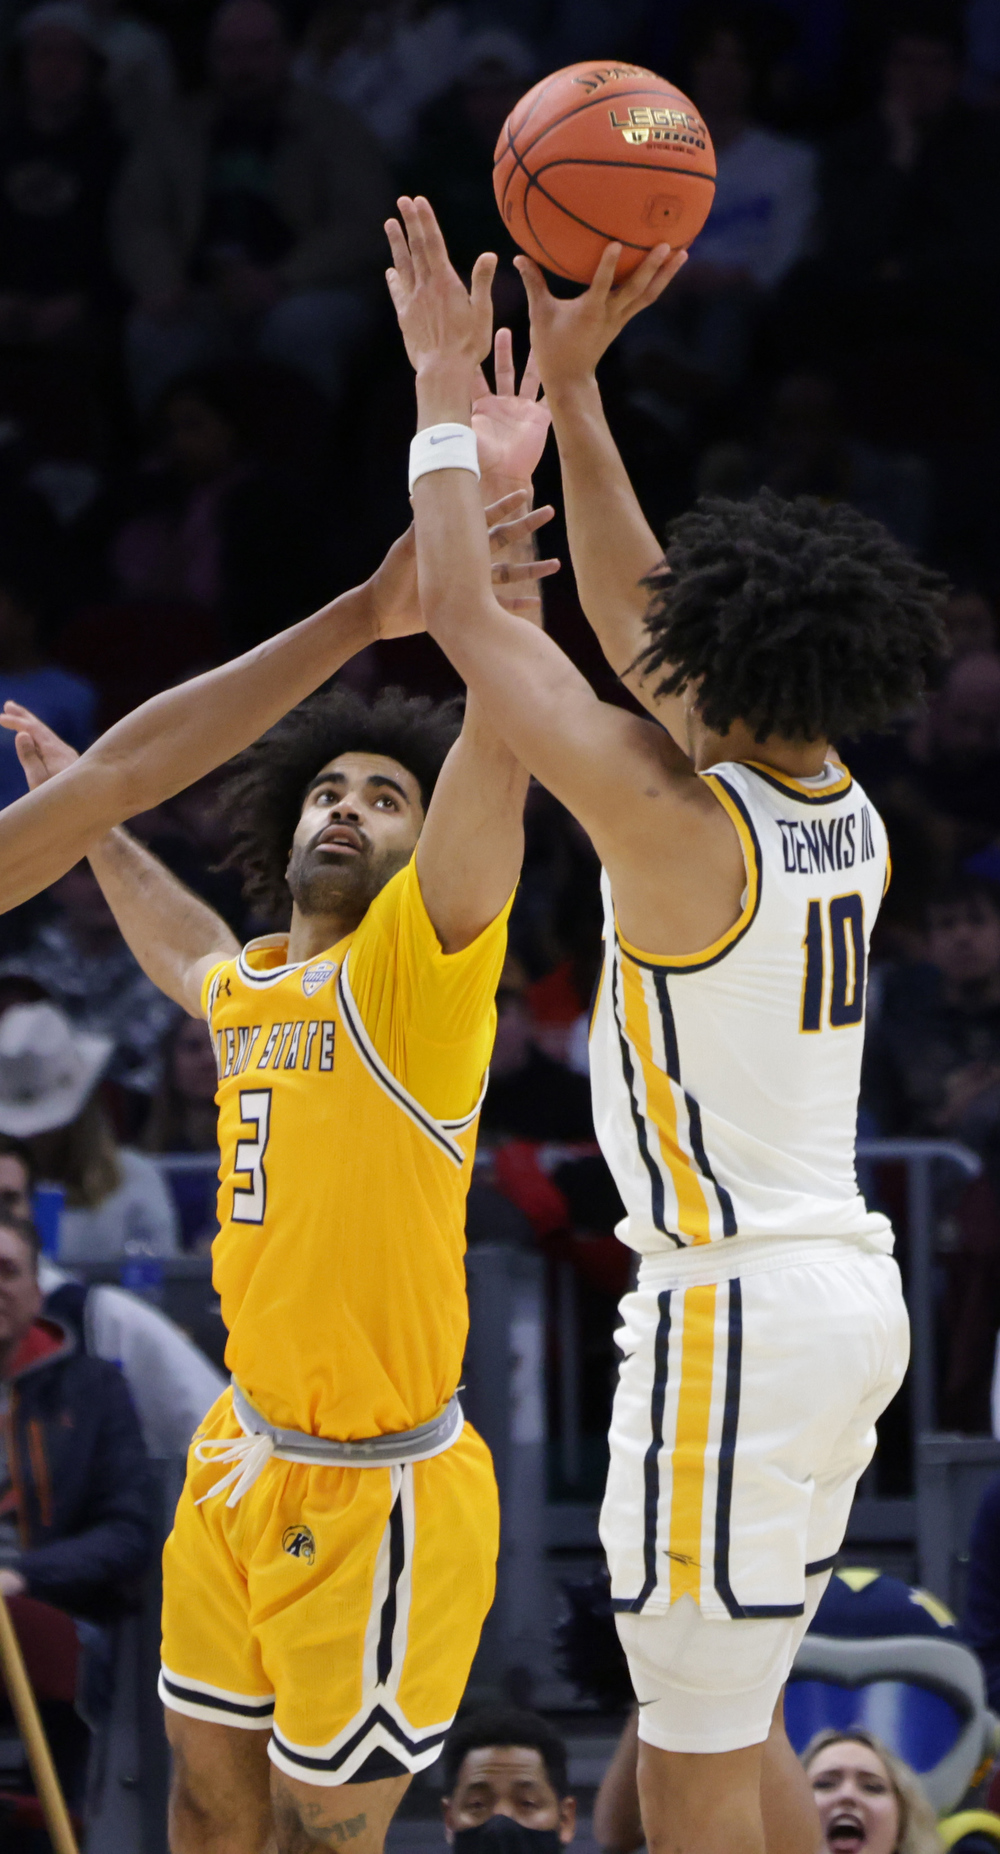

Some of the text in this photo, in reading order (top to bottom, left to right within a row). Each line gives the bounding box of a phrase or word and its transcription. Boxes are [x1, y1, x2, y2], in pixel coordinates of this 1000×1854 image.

[608, 107, 706, 138] LEGACY
[775, 813, 856, 874] DENNIS
[798, 890, 865, 1034] 10
[256, 1021, 336, 1072] STATE
[231, 1088, 273, 1226] 3
